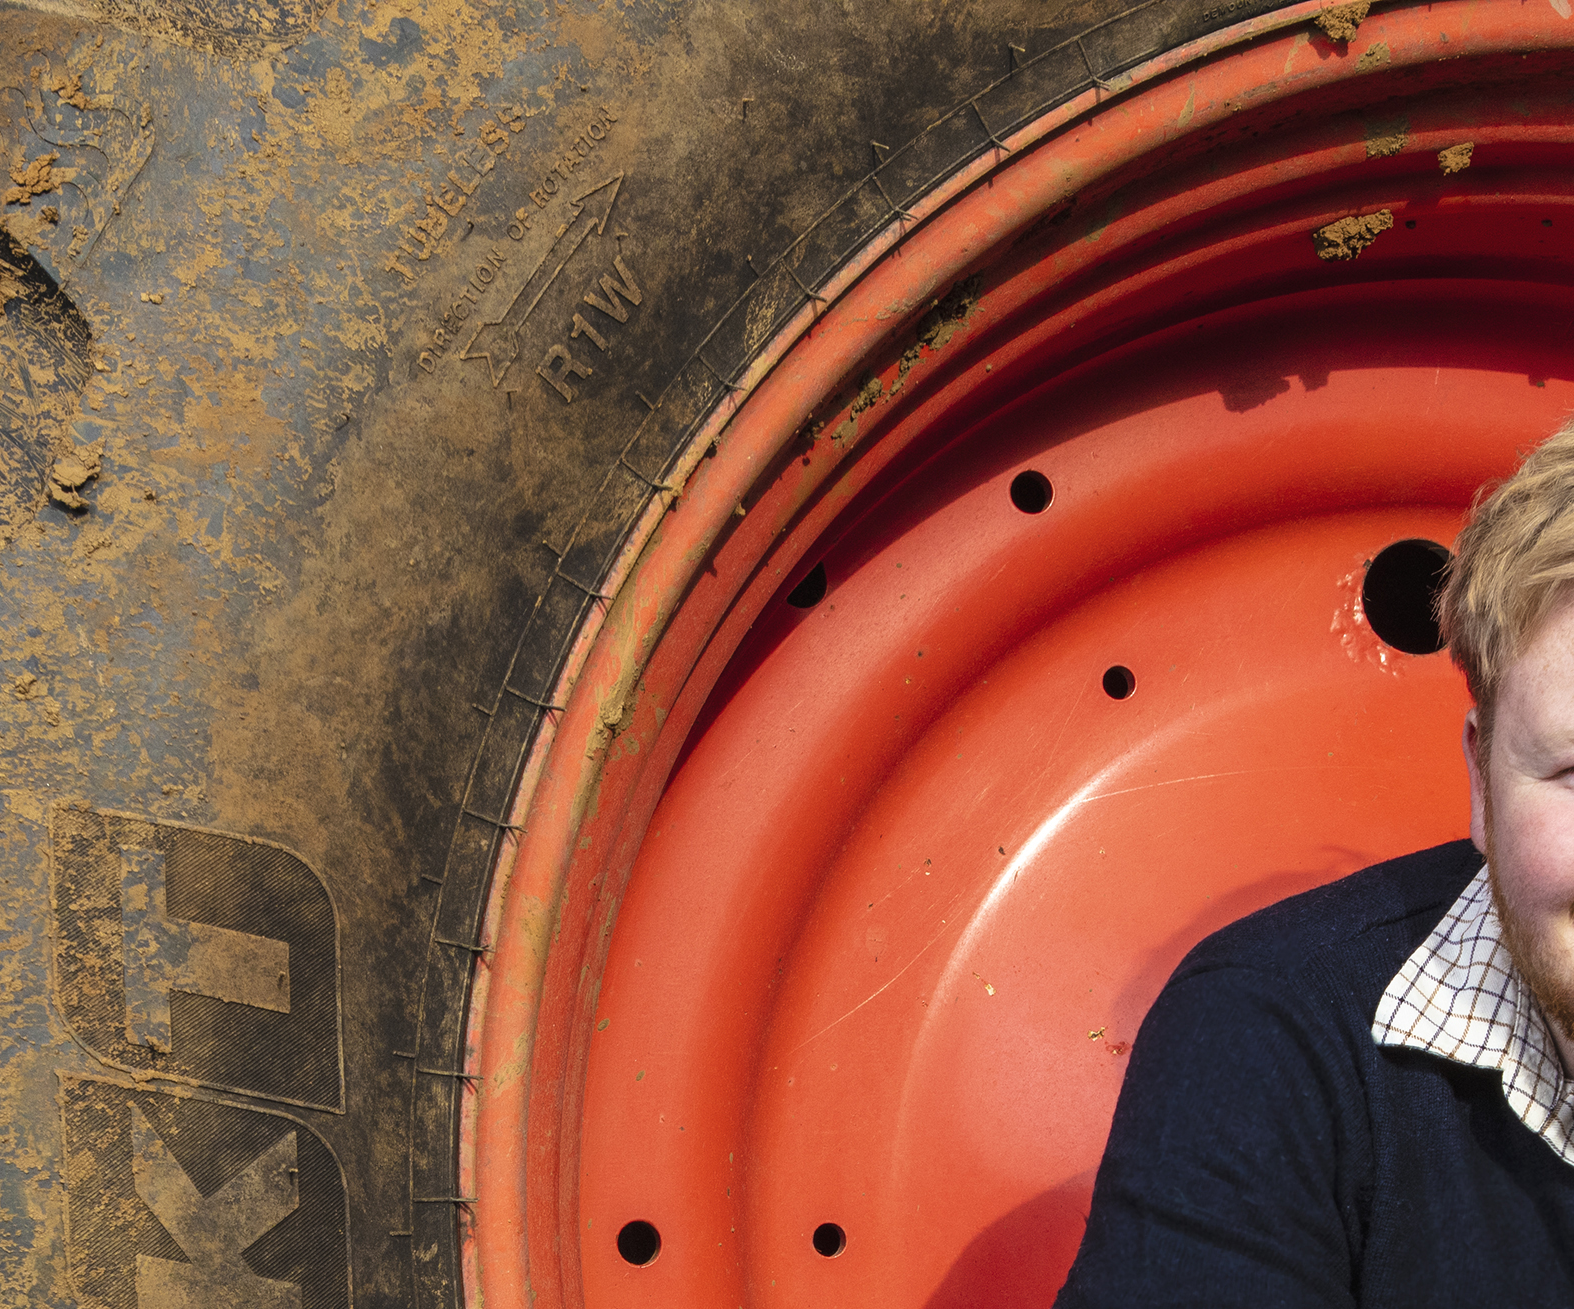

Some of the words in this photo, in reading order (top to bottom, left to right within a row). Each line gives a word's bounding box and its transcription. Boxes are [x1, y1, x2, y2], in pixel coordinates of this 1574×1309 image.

[384, 104, 528, 287] TUBELESS
[416, 246, 507, 375] DIRECTION
[506, 206, 531, 242] OF
[528, 105, 619, 211] ROTATION
